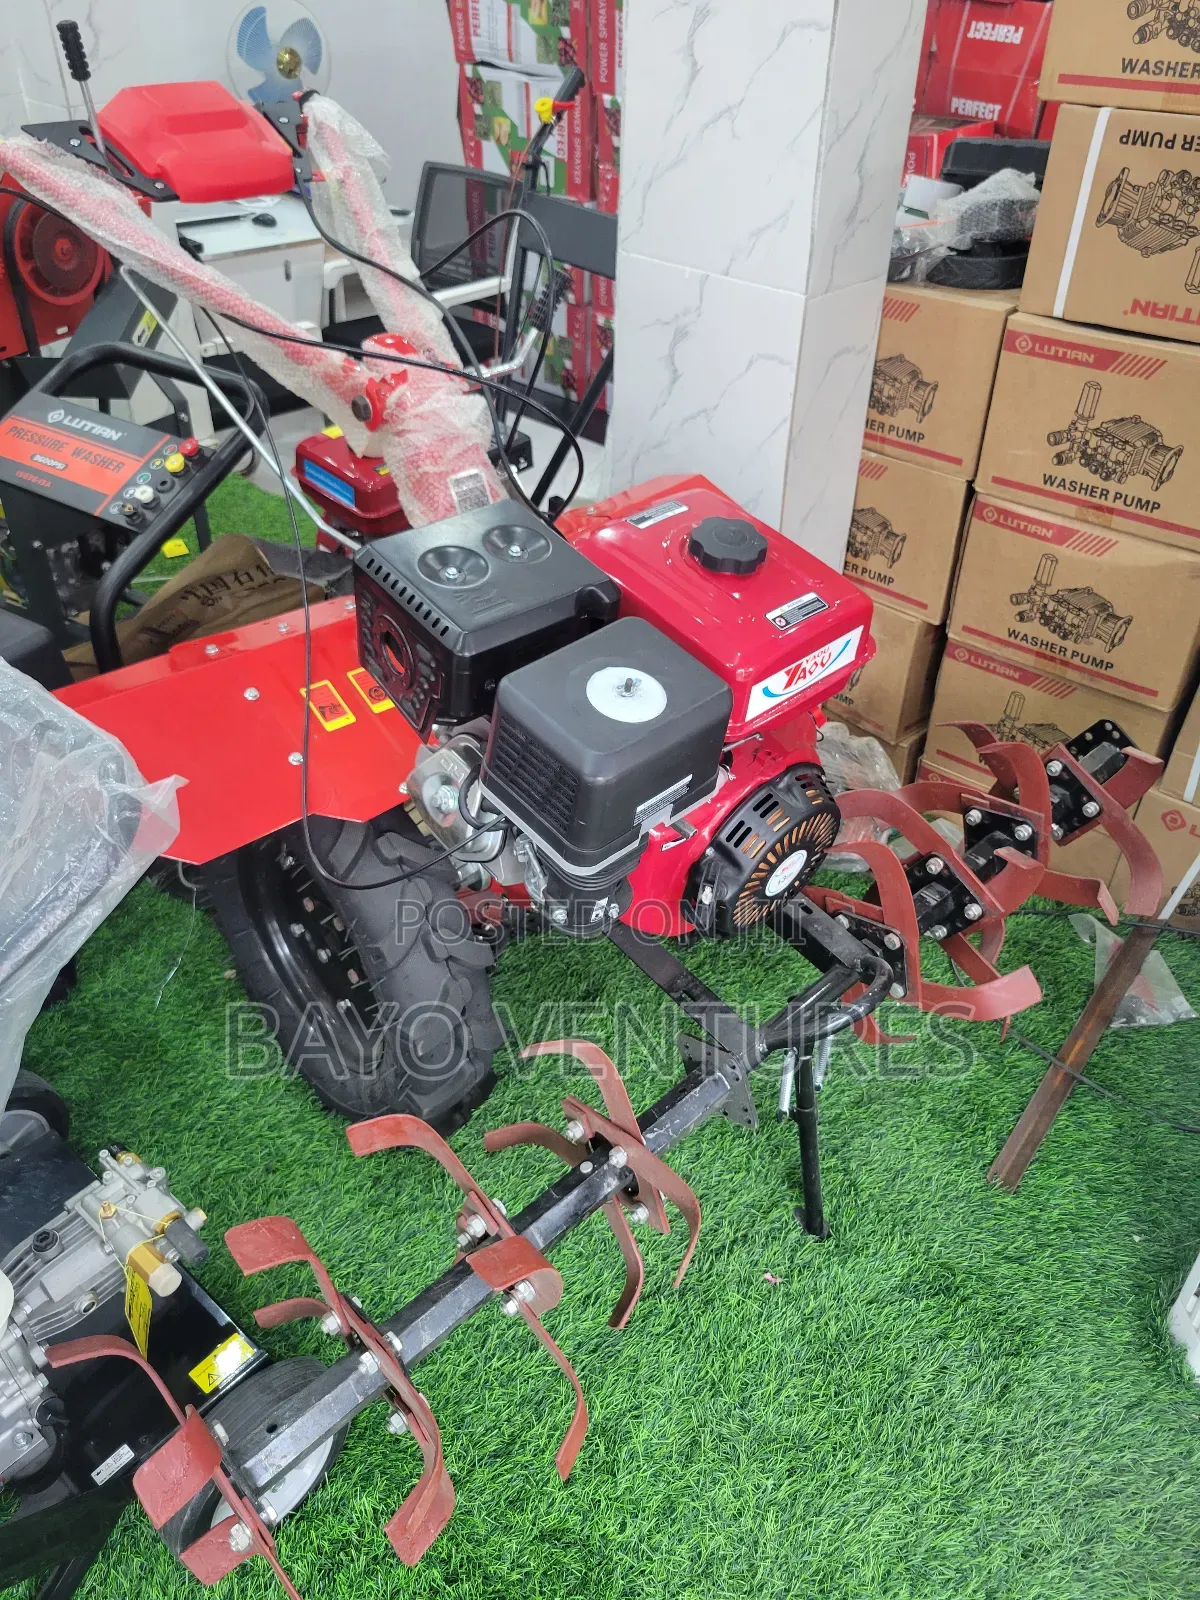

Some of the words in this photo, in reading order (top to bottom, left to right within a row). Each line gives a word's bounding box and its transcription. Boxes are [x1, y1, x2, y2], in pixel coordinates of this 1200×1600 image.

[966, 21, 1024, 44] PERFECT
[599, 42, 608, 83] POWER
[1121, 57, 1200, 79] WASHER
[951, 97, 1001, 121] PERFECT
[1119, 129, 1177, 150] PUMP
[573, 136, 582, 184] SPRAYER
[1130, 298, 1200, 326] TIAN
[1034, 339, 1095, 364] LUTIAN
[62, 415, 122, 441] LUTIAN
[888, 424, 925, 443] PUMP
[5, 425, 69, 453] PRESSURE
[70, 446, 126, 474] WASHER
[1042, 473, 1110, 502] WASHER
[1112, 491, 1161, 515] PUMP
[999, 514, 1053, 539] LUTIAN
[861, 566, 895, 586] PUMP
[806, 646, 831, 664] YAOU
[1007, 627, 1068, 657] WASHER
[1070, 645, 1114, 673] PUMP
[970, 655, 1021, 680] LUTIAN
